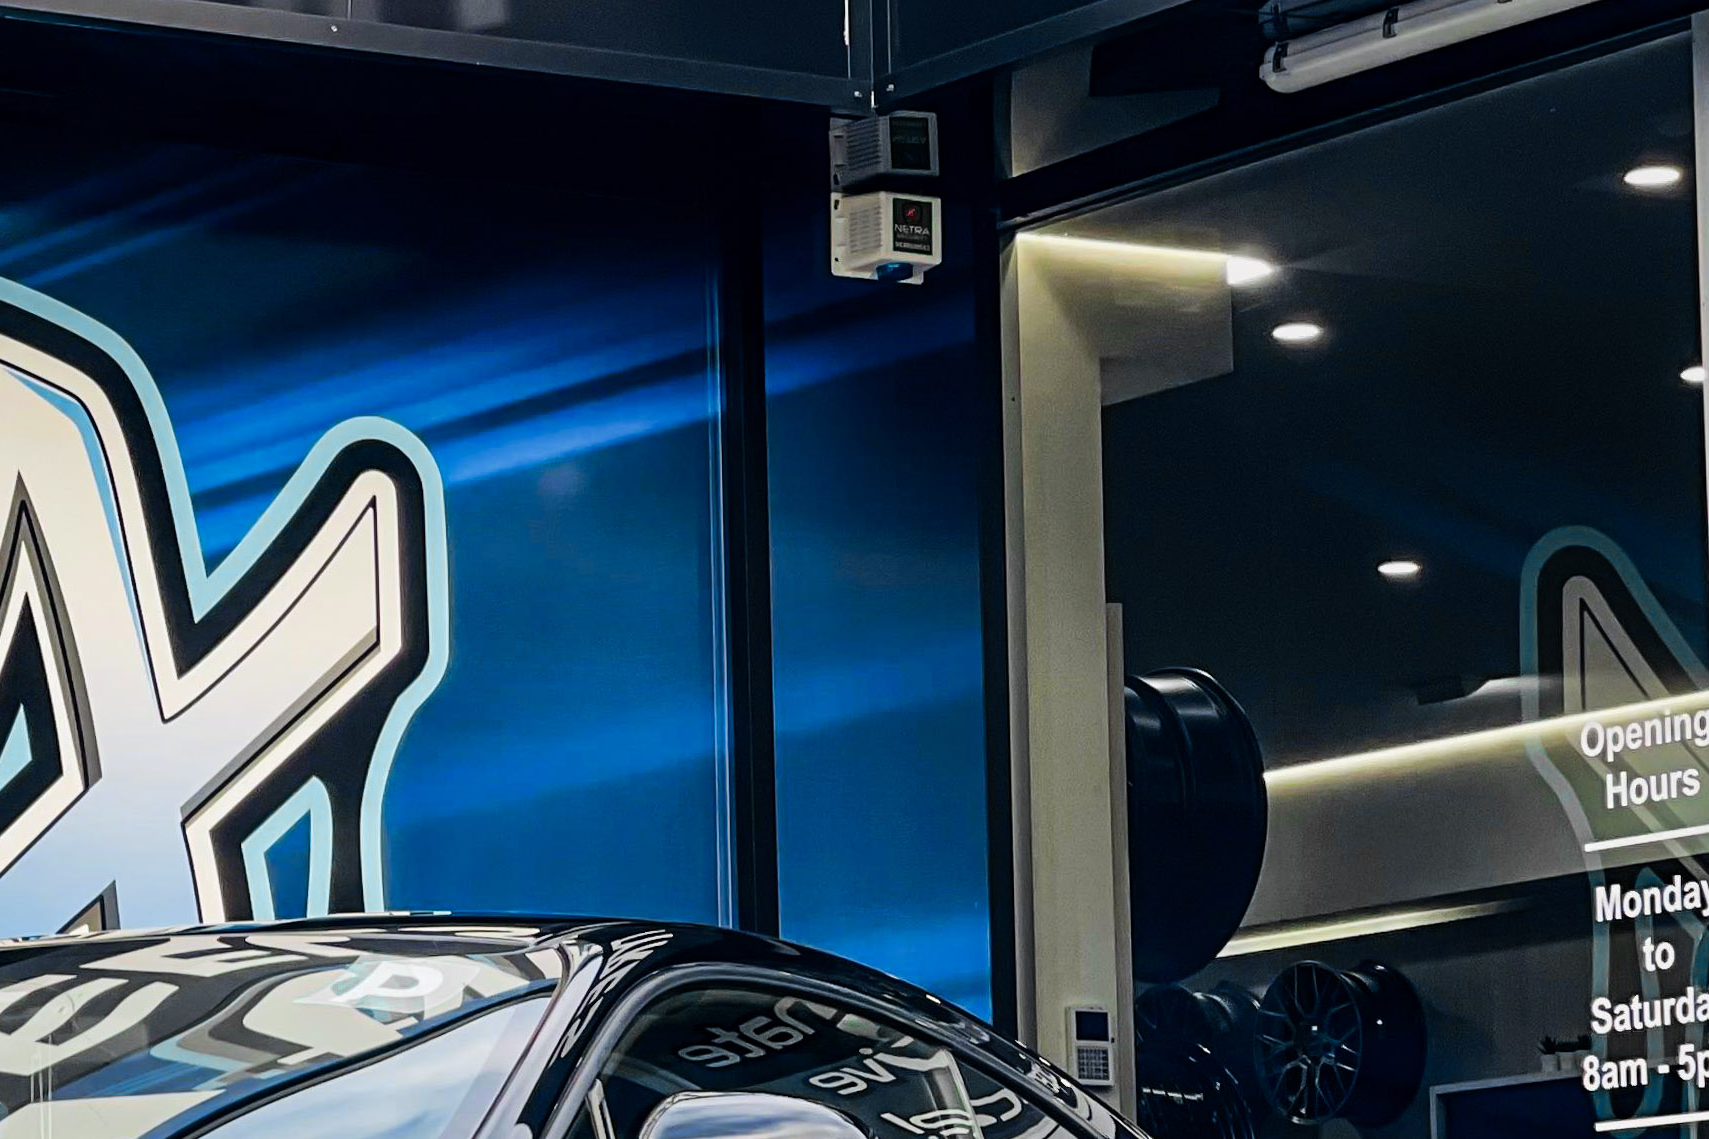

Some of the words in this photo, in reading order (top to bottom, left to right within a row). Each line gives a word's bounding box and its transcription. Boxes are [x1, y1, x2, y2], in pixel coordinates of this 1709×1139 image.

[1580, 709, 1709, 762] Opening
[1606, 768, 1701, 809] Hours
[1595, 874, 1709, 922] Monday
[1642, 937, 1675, 972] to
[1583, 1055, 1648, 1091] 8am
[1657, 1064, 1670, 1074] -
